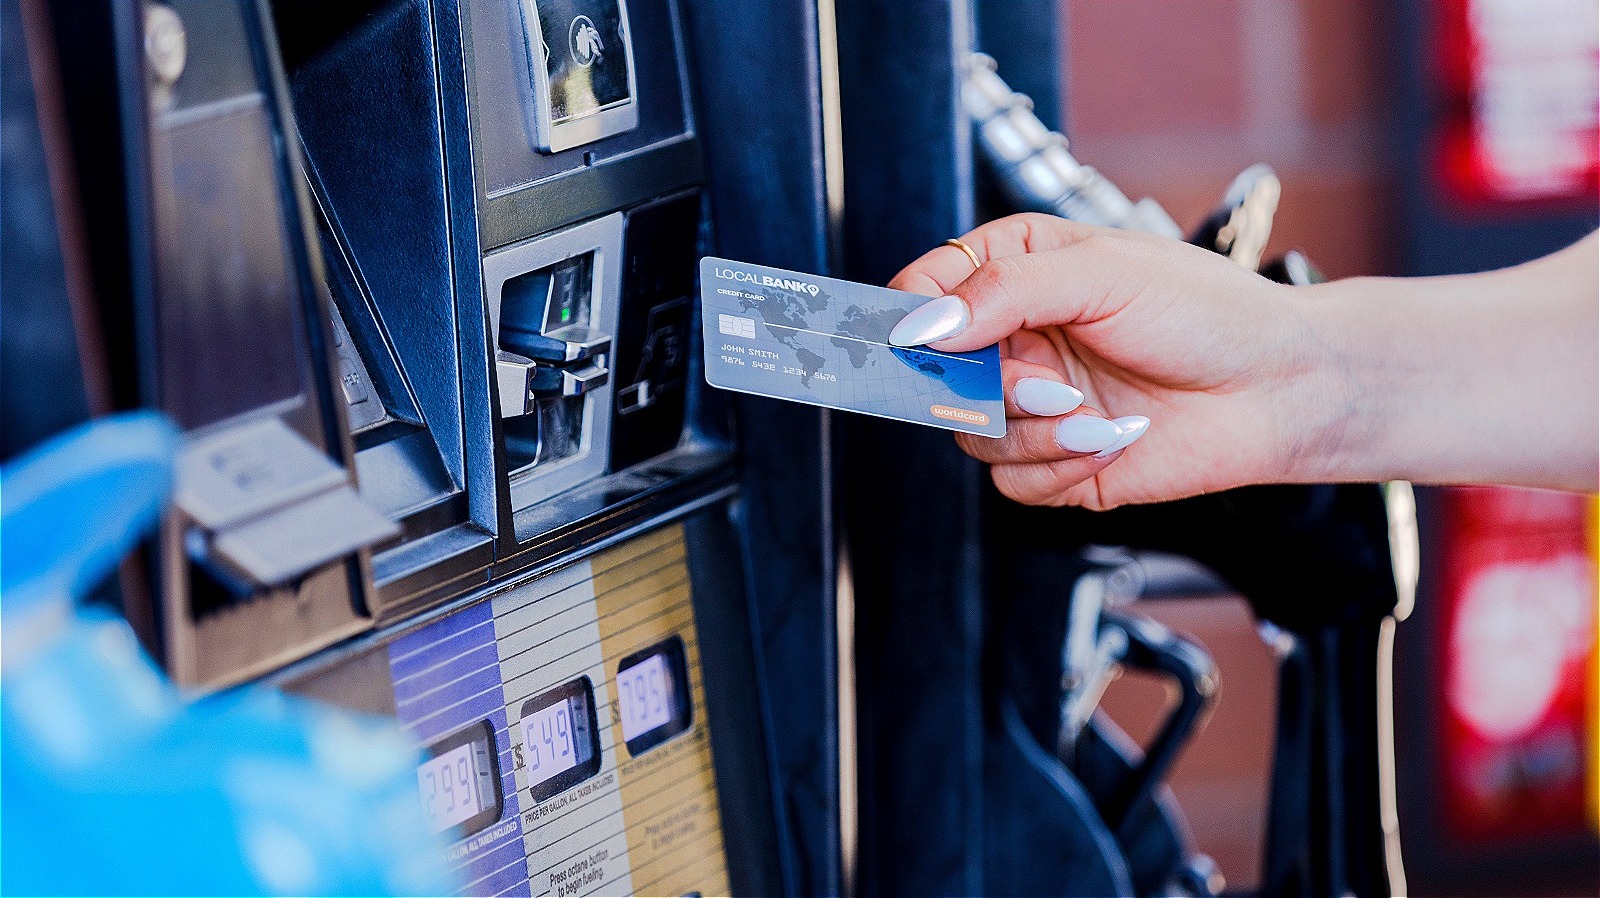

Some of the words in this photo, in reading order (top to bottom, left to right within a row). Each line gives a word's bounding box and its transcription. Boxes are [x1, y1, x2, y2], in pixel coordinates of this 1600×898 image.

[715, 267, 809, 294] LOCALBANK
[717, 288, 744, 298] CREDIT
[744, 293, 765, 301] CARD
[721, 344, 745, 354] JOHN
[748, 348, 779, 360] SMITH
[721, 355, 745, 366] 9876
[752, 361, 776, 371] 5432
[783, 366, 807, 377] 1234
[814, 371, 837, 382] 5678
[934, 407, 985, 422] worldcard
[524, 809, 540, 825] PRICE
[539, 806, 549, 818] PER
[569, 792, 578, 804] ALL
[493, 821, 517, 842] INCLUDED
[550, 870, 567, 887] Press
[567, 859, 588, 878] octane
[589, 849, 608, 867] button
[557, 886, 565, 898] to
[565, 877, 582, 894] begin
